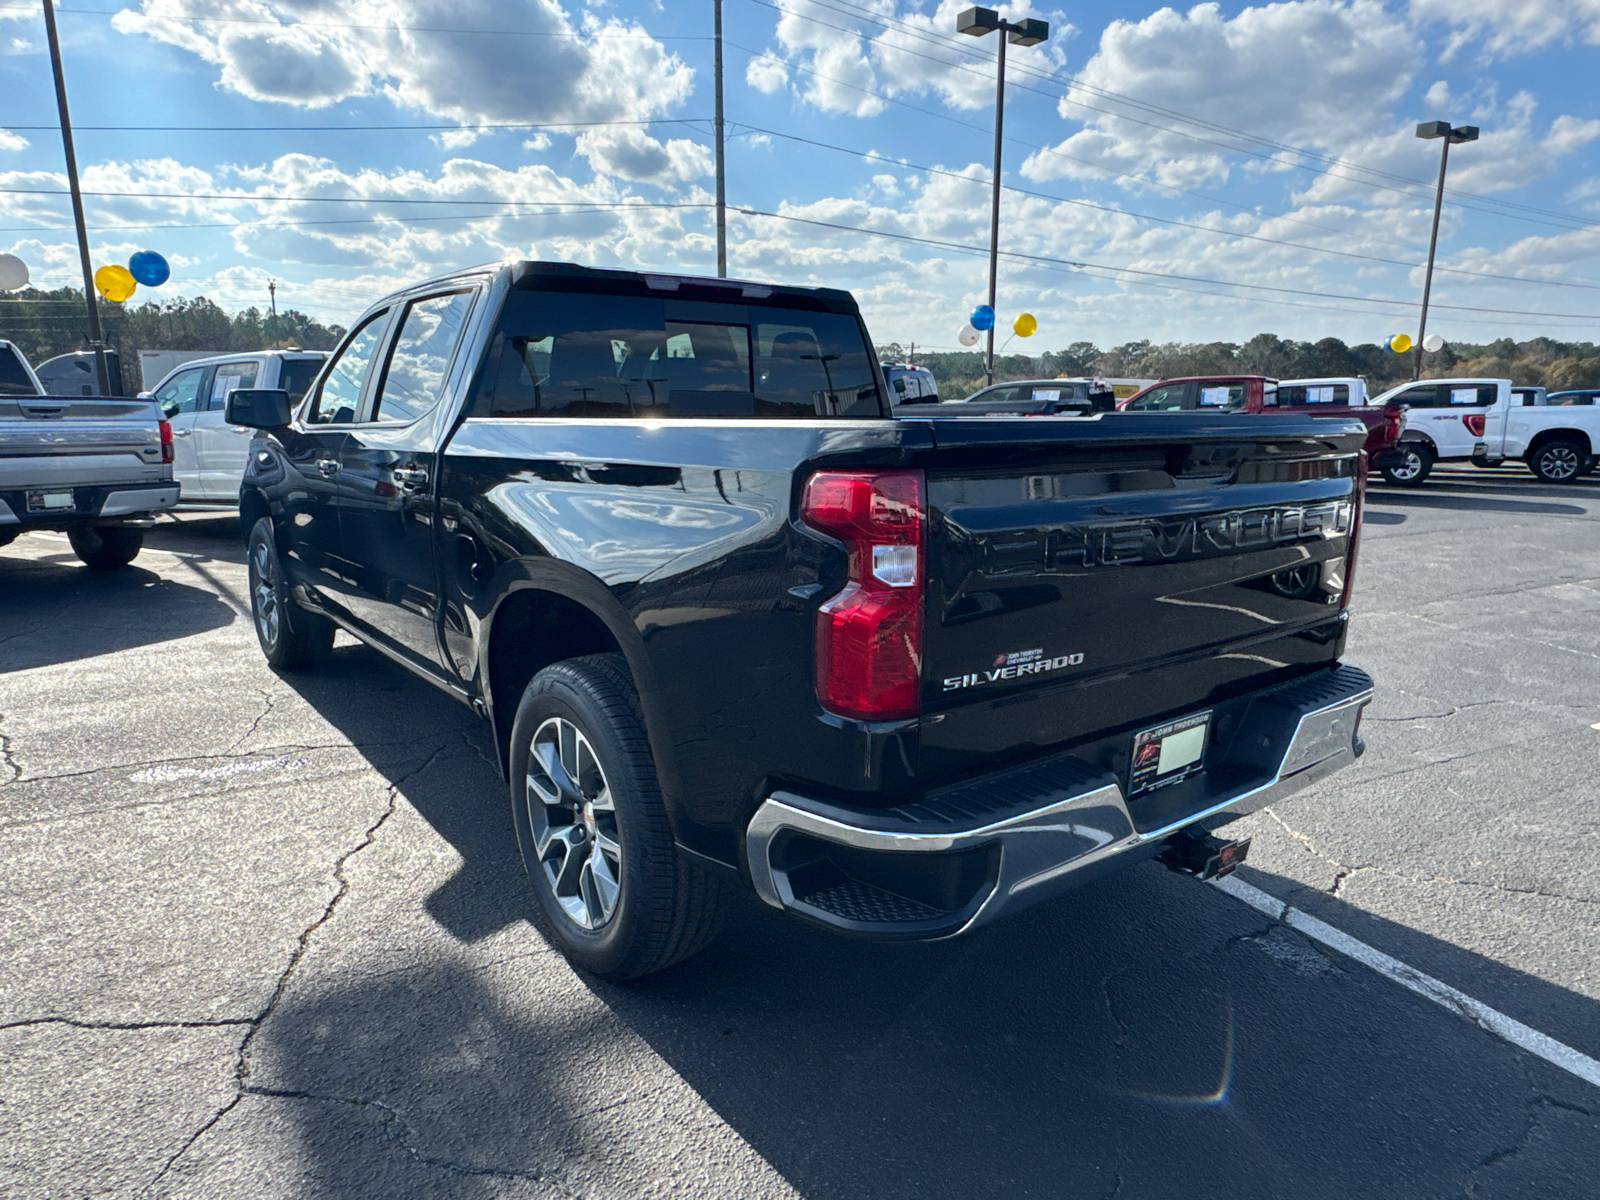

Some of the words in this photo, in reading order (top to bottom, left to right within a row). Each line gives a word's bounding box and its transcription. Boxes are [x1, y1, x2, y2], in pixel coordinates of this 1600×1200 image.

[984, 502, 1349, 579] CHEVROLET
[942, 652, 1084, 692] SILVERADO
[1151, 725, 1174, 739] JOHN
[1174, 713, 1210, 731] THORNTON
